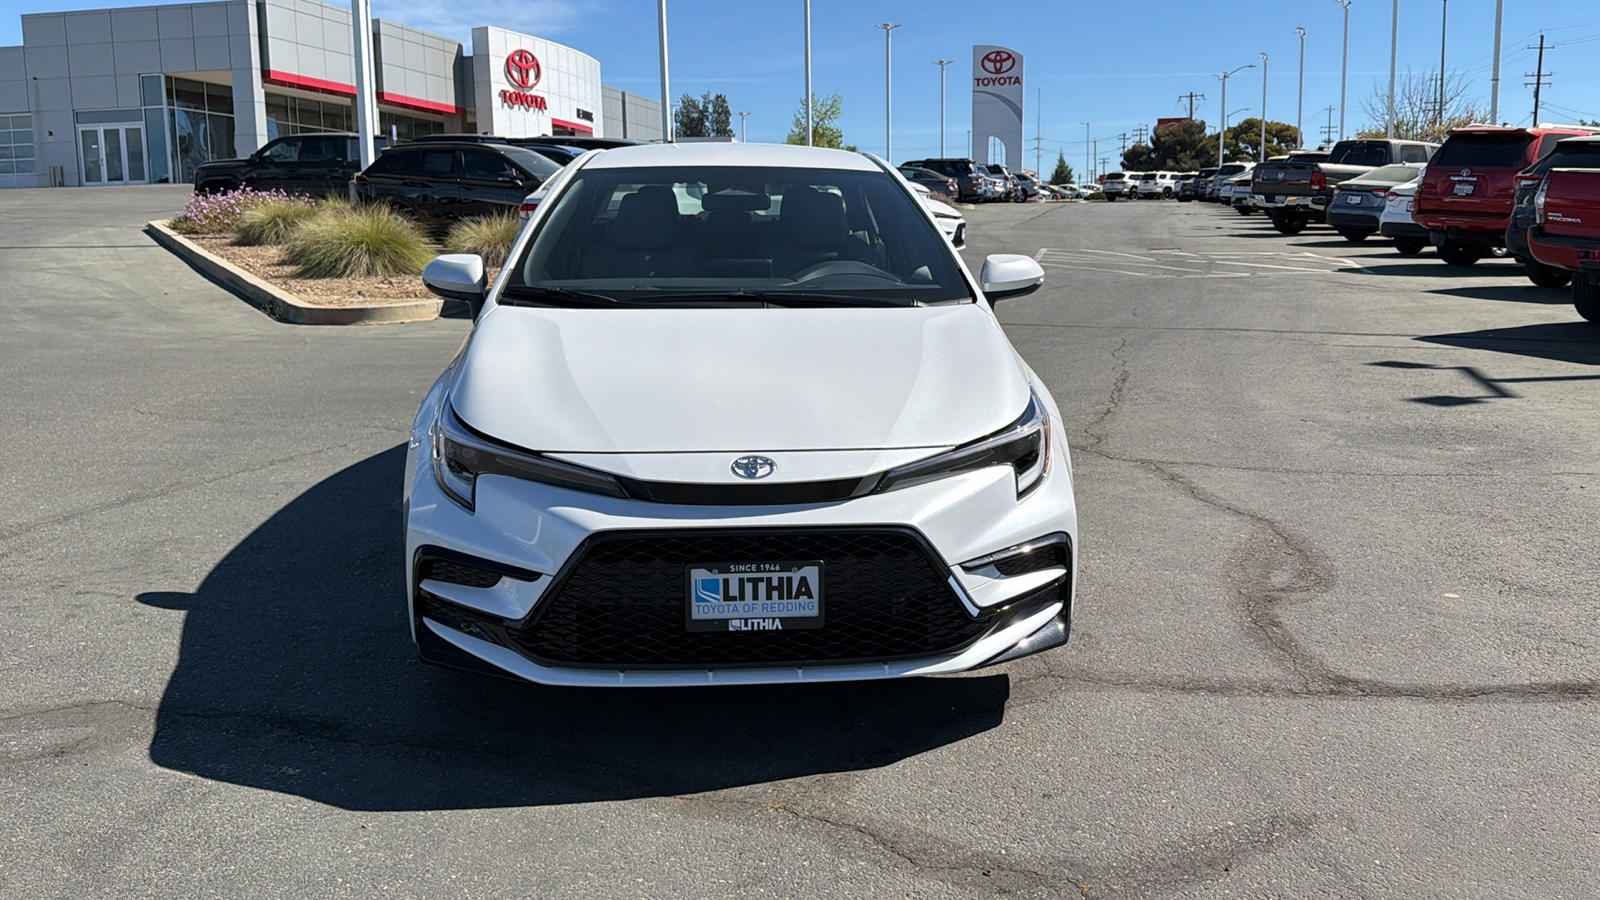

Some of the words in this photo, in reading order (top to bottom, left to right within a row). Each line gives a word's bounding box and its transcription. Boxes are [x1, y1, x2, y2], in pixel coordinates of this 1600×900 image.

[974, 76, 1021, 87] TOYOTA
[501, 89, 548, 110] TOYOTA
[729, 564, 757, 572] SINCE
[760, 563, 781, 571] 1946
[722, 576, 814, 602] LITHIA
[695, 603, 739, 615] TOYOTA
[743, 603, 758, 613] OF
[761, 601, 815, 613] REDDING
[740, 618, 783, 631] LITHIA
